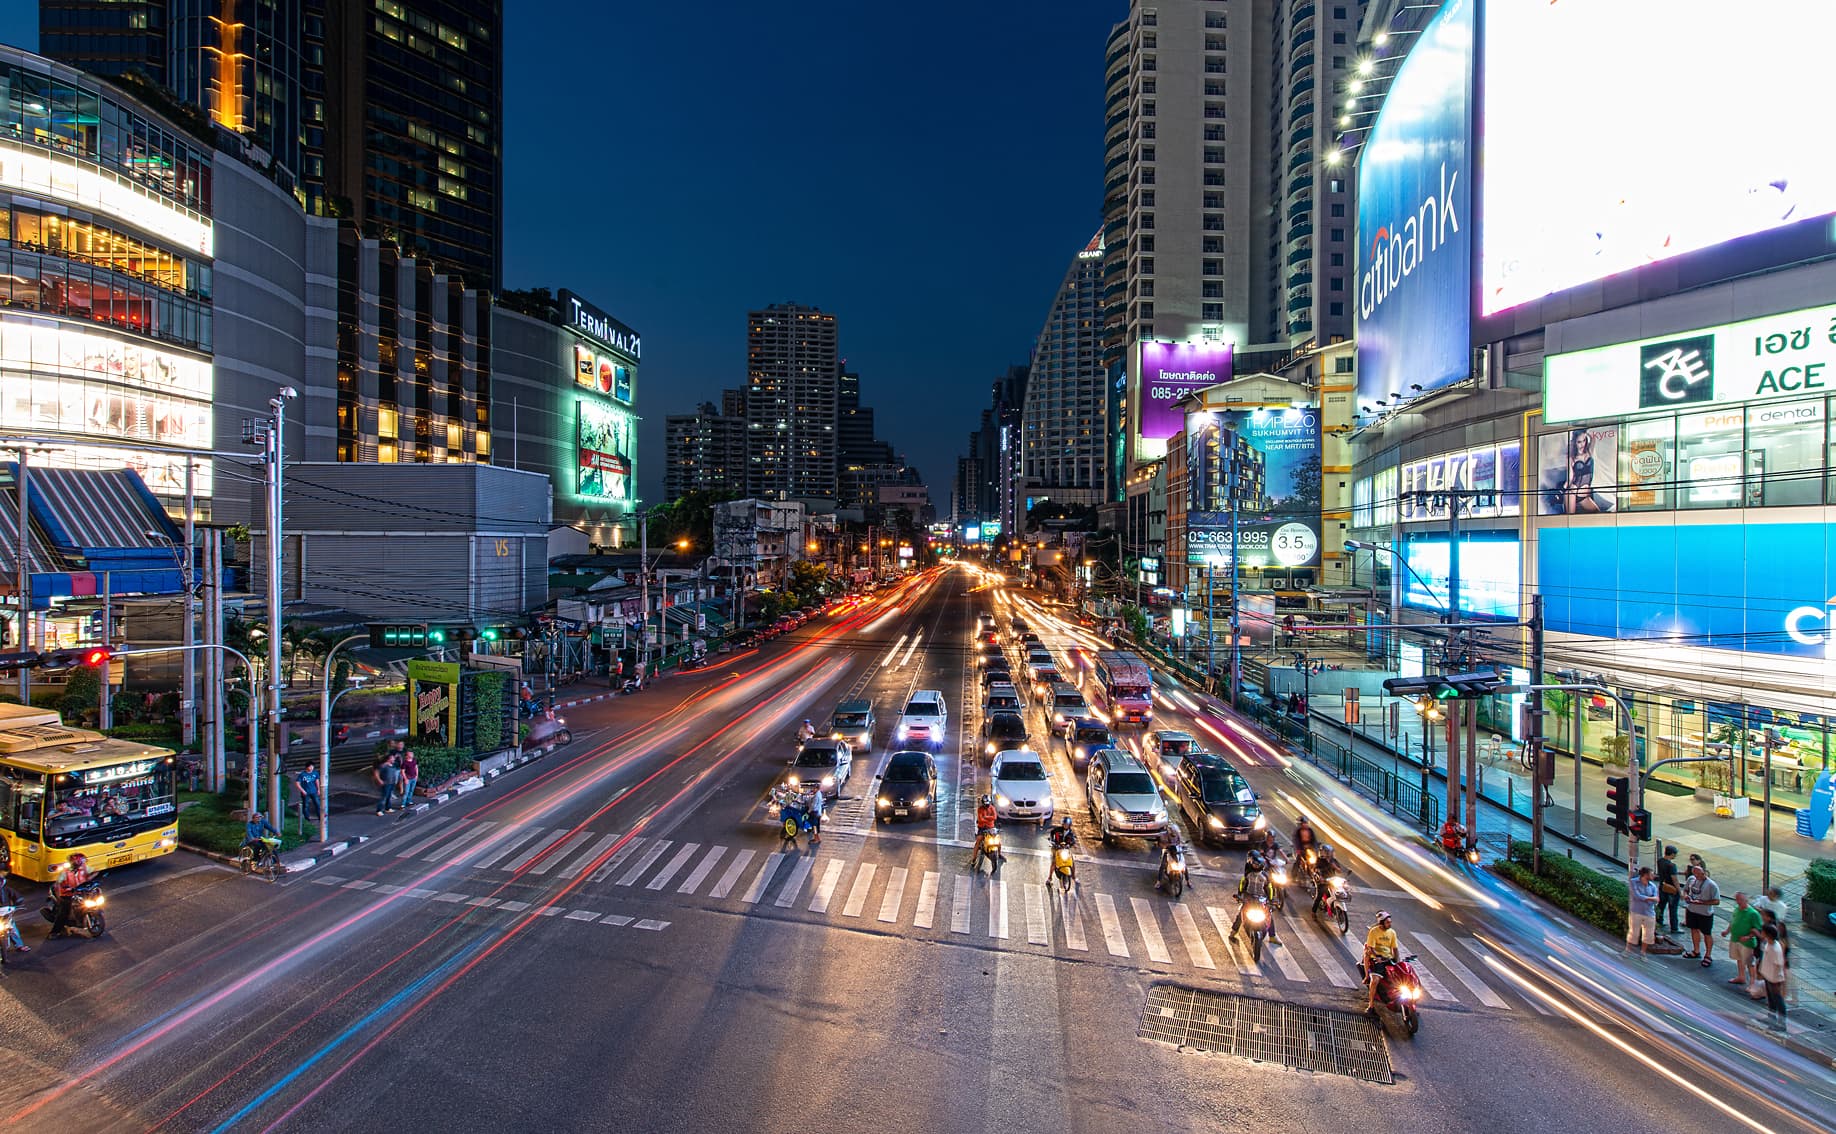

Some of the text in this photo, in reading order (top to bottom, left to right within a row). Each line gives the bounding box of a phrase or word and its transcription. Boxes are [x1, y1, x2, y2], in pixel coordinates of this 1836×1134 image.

[1361, 161, 1459, 321] citibank
[630, 334, 641, 359] 21
[1159, 369, 1216, 381] โฆษณาติดต่อ
[1755, 363, 1826, 395] ACE
[1243, 414, 1315, 430] TRAPEZO
[1760, 406, 1817, 422] dental
[1252, 429, 1302, 437] SUKHUMVIT
[1592, 429, 1615, 441] kyra
[495, 539, 509, 556] VS
[1278, 535, 1304, 549] 3.5
[418, 686, 441, 709] Happy
[424, 715, 440, 734] Day
